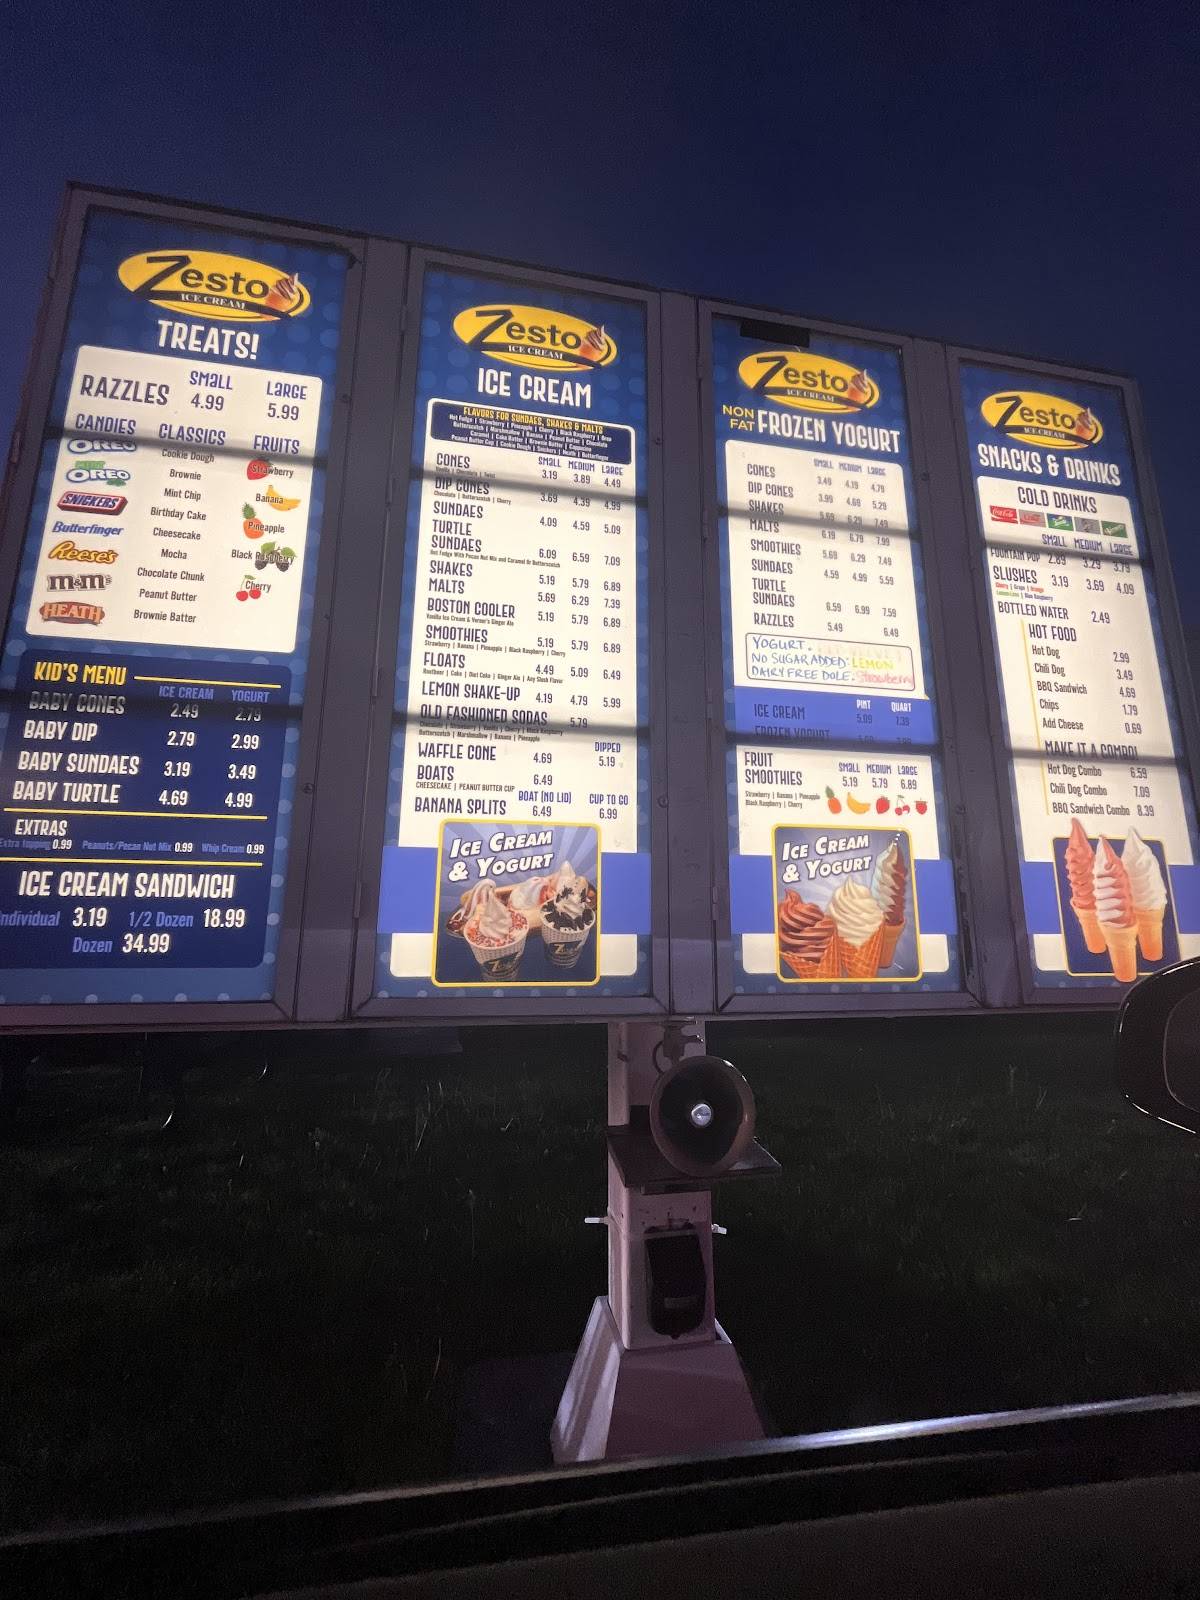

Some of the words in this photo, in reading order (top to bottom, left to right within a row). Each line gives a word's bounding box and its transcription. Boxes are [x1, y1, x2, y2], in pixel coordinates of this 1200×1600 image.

[133, 255, 270, 298] Zesto
[181, 293, 200, 302] ICE
[204, 295, 246, 310] CREAM
[468, 309, 582, 349] Zesto
[158, 320, 260, 360] TREATS!
[508, 344, 525, 353] ICE
[527, 346, 563, 360] CREAM
[752, 355, 849, 393] Zesto
[80, 374, 170, 406] RAZZLES
[477, 367, 511, 396] ICE
[519, 374, 592, 409] CREAM
[190, 393, 225, 411] 4.99
[267, 402, 300, 421] 5.99
[994, 395, 1076, 429] Zesto
[463, 406, 494, 419] FLAVORS
[496, 412, 510, 421] FOR
[546, 418, 573, 430] SHAKES
[581, 423, 604, 435] MALTS
[722, 405, 755, 419] NON
[757, 409, 827, 443] FROZEN
[831, 421, 901, 453] YOGURT
[730, 418, 755, 432] FAT
[75, 413, 137, 435] CANDIES
[158, 423, 226, 446] CLASSICS
[253, 434, 300, 454] FRUITS
[436, 452, 470, 469] CONES
[977, 443, 1043, 474] SNACKS
[1046, 453, 1060, 476] &
[1063, 456, 1121, 486] DRINKS
[169, 468, 202, 480] Brownie
[747, 463, 776, 478] CONES
[164, 488, 182, 499] Mint
[184, 490, 201, 502] Chip
[748, 481, 762, 494] DIP
[765, 483, 794, 498] CONES
[62, 493, 119, 509] SNICKERS
[1017, 486, 1050, 507] COLD
[1052, 490, 1098, 514] DRINKS
[150, 506, 184, 521] Birthday
[187, 510, 207, 521] Cake
[433, 500, 483, 519] SUNDAES
[52, 520, 124, 537] Butterfinger
[152, 527, 201, 540] Cheesecake
[432, 519, 472, 536] TURTLE
[539, 516, 557, 527] 4.09
[573, 520, 590, 531] 4.59
[604, 524, 621, 535] 5.09
[48, 540, 119, 564] Reese's
[431, 534, 482, 553] SUNDAES
[750, 538, 801, 556] SMOOTHIES
[161, 548, 188, 560] Mocha
[137, 567, 177, 579] Chocolate
[180, 569, 205, 582] Chunk
[430, 559, 473, 577] SHAKES
[751, 558, 793, 574] SUNDAES
[993, 565, 1038, 584] SLUSHES
[245, 580, 271, 593] Cherry
[428, 578, 465, 594] MALTS
[752, 577, 786, 592] TURTLE
[1051, 574, 1069, 587] 3.19
[1086, 578, 1104, 591] 3.69
[1116, 582, 1135, 595] 4.09
[139, 588, 169, 600] Peanut
[171, 590, 197, 602] Butter
[753, 591, 795, 607] SUNDAES
[133, 609, 167, 621] Brownie
[169, 612, 196, 623] Batter
[427, 597, 470, 615] BOSTON
[474, 601, 515, 619] COOLER
[998, 600, 1037, 617] BOTTLED
[1040, 605, 1069, 620] WATER
[1091, 610, 1111, 623] 2.49
[753, 612, 794, 628] RAZZLES
[426, 624, 488, 643] SMOOTHIES
[827, 622, 843, 633] 5.49
[883, 627, 899, 638] 6.49
[1028, 623, 1048, 640] HOT
[1050, 625, 1078, 642] FOOD
[424, 651, 465, 669] FLOATS
[1112, 651, 1130, 663] 2.99
[34, 661, 78, 683] KID'S
[82, 664, 127, 686] MENU
[1034, 662, 1050, 674] Chili
[1051, 663, 1066, 677] Dog
[1116, 668, 1133, 680] 3.49
[158, 686, 176, 698] ICE
[178, 687, 214, 700] CREAM
[231, 690, 271, 703] YOGURT
[421, 681, 460, 697] LEMON
[464, 683, 520, 701] SHAKE-UP
[1036, 680, 1052, 692] BBQ
[1053, 681, 1087, 694] Sandwich
[1119, 686, 1136, 698] 4.69
[754, 703, 769, 718] ICE
[772, 704, 805, 721] CREAM
[1039, 698, 1060, 711] Chips
[420, 704, 442, 720] OLD
[446, 706, 508, 724] FASHIONED
[511, 709, 548, 726] SODAS
[23, 720, 68, 740] BABY
[71, 722, 98, 741] DIP
[1042, 717, 1057, 729] Add
[1058, 718, 1084, 731] Cheese
[1124, 722, 1142, 734] 0.69
[167, 730, 196, 747] 2.79
[231, 734, 260, 750] 2.99
[594, 741, 621, 753] DIPPED
[418, 742, 463, 760] WAFFLE
[467, 744, 496, 761] CONE
[533, 752, 552, 764] 4.69
[598, 756, 616, 767] 5.19
[744, 751, 773, 767] FRUIT
[17, 751, 63, 772] BABY
[66, 753, 140, 775] SUNDAES
[164, 761, 191, 777] 3.19
[228, 764, 256, 780] 3.49
[416, 764, 454, 781] BOATS
[533, 774, 553, 786] 6.49
[745, 768, 803, 786] SMOOTHIES
[416, 781, 452, 790] CHEESECAKE
[459, 783, 481, 792] PEANUT
[482, 784, 503, 793] BUTTER
[842, 776, 858, 788] 5.19
[871, 777, 888, 789] 5.79
[900, 778, 917, 790] 6.89
[1067, 783, 1082, 797] Dog
[1083, 784, 1108, 796] Combo
[12, 780, 58, 801] BABY
[63, 782, 121, 804] TURTLE
[159, 790, 188, 806] 4.69
[225, 792, 253, 808] 4.99
[414, 796, 462, 814] BANANA
[467, 798, 507, 816] SPLITS
[532, 805, 552, 817] 6.49
[599, 808, 618, 819] 6.99
[15, 819, 68, 837] EXTRAS
[782, 863, 801, 884] &
[18, 870, 54, 897] ICE
[58, 871, 129, 897] CREAM
[134, 872, 235, 899] SANDWICH
[72, 907, 108, 927] 3.19
[129, 911, 152, 928] 1/2
[155, 912, 193, 928] Dozen
[203, 908, 246, 928] 18.99
[72, 937, 113, 953] Dozen
[122, 933, 171, 953] 34.99
